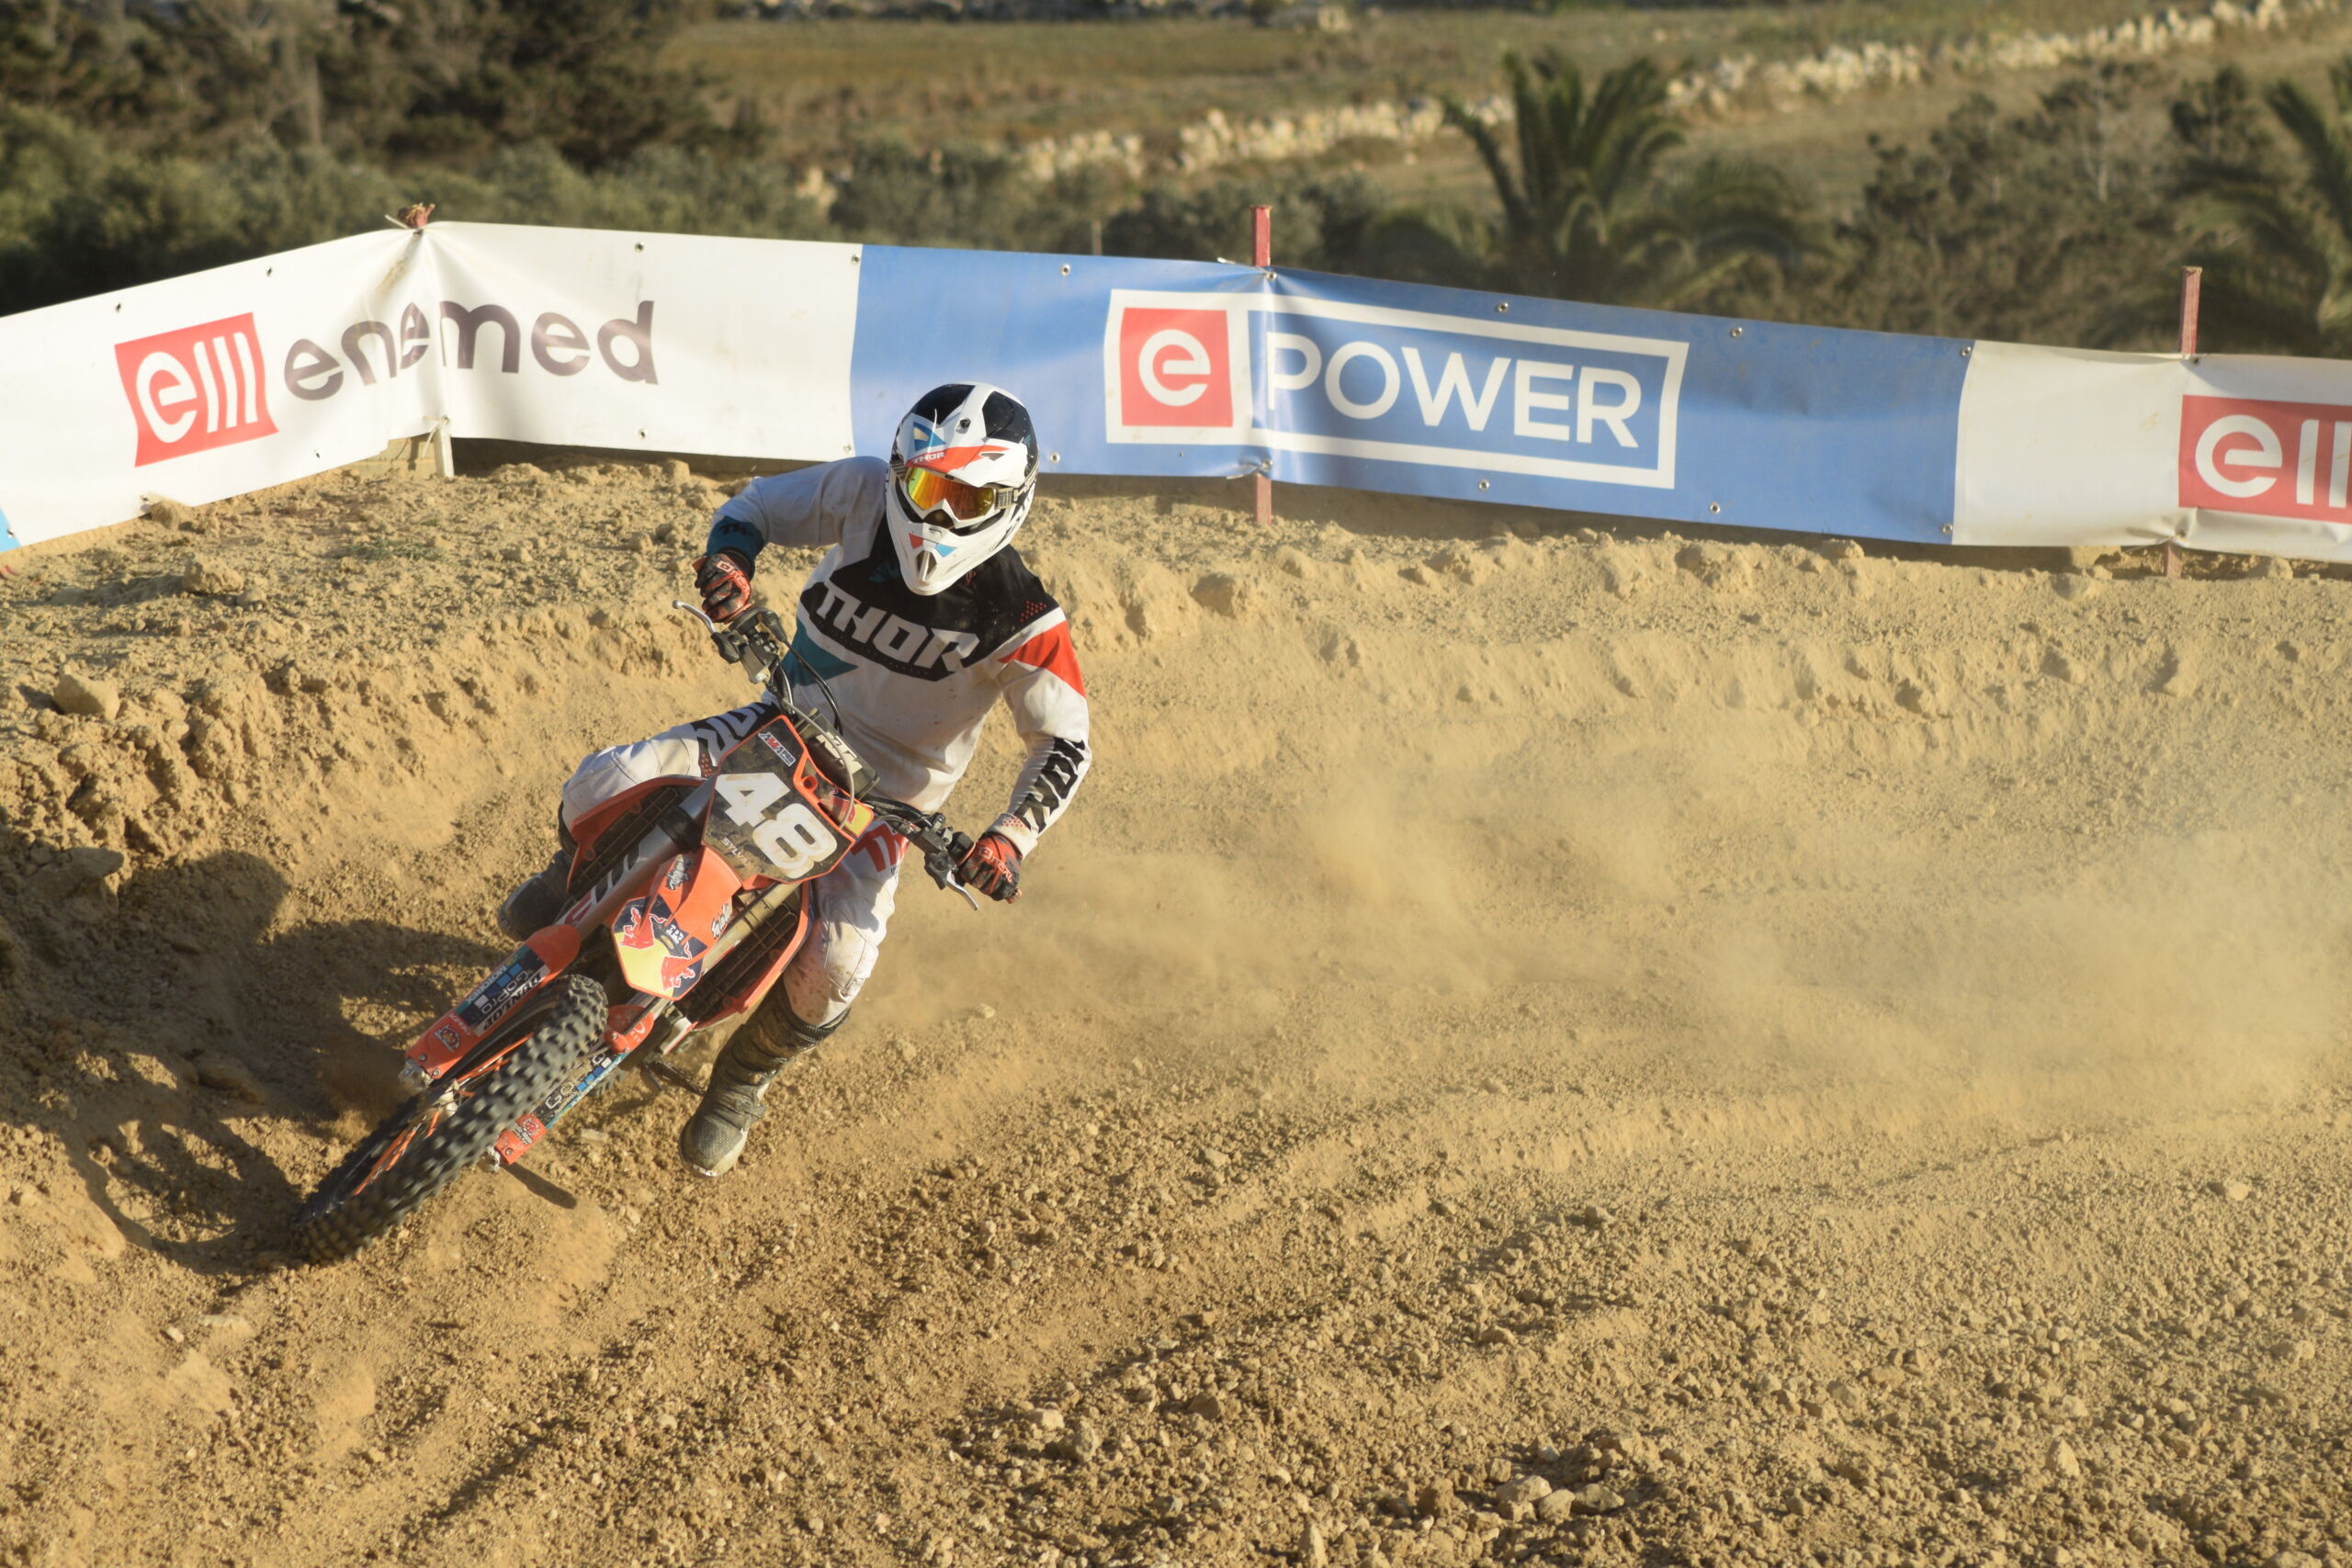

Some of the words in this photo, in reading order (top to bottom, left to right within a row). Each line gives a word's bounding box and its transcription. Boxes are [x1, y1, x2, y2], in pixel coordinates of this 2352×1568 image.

[285, 300, 659, 400] enemed
[1267, 331, 1643, 449] POWER
[910, 451, 945, 464] THOR
[815, 581, 980, 672] THOR
[715, 772, 838, 879] 48
[466, 964, 507, 1003] MOTOREX
